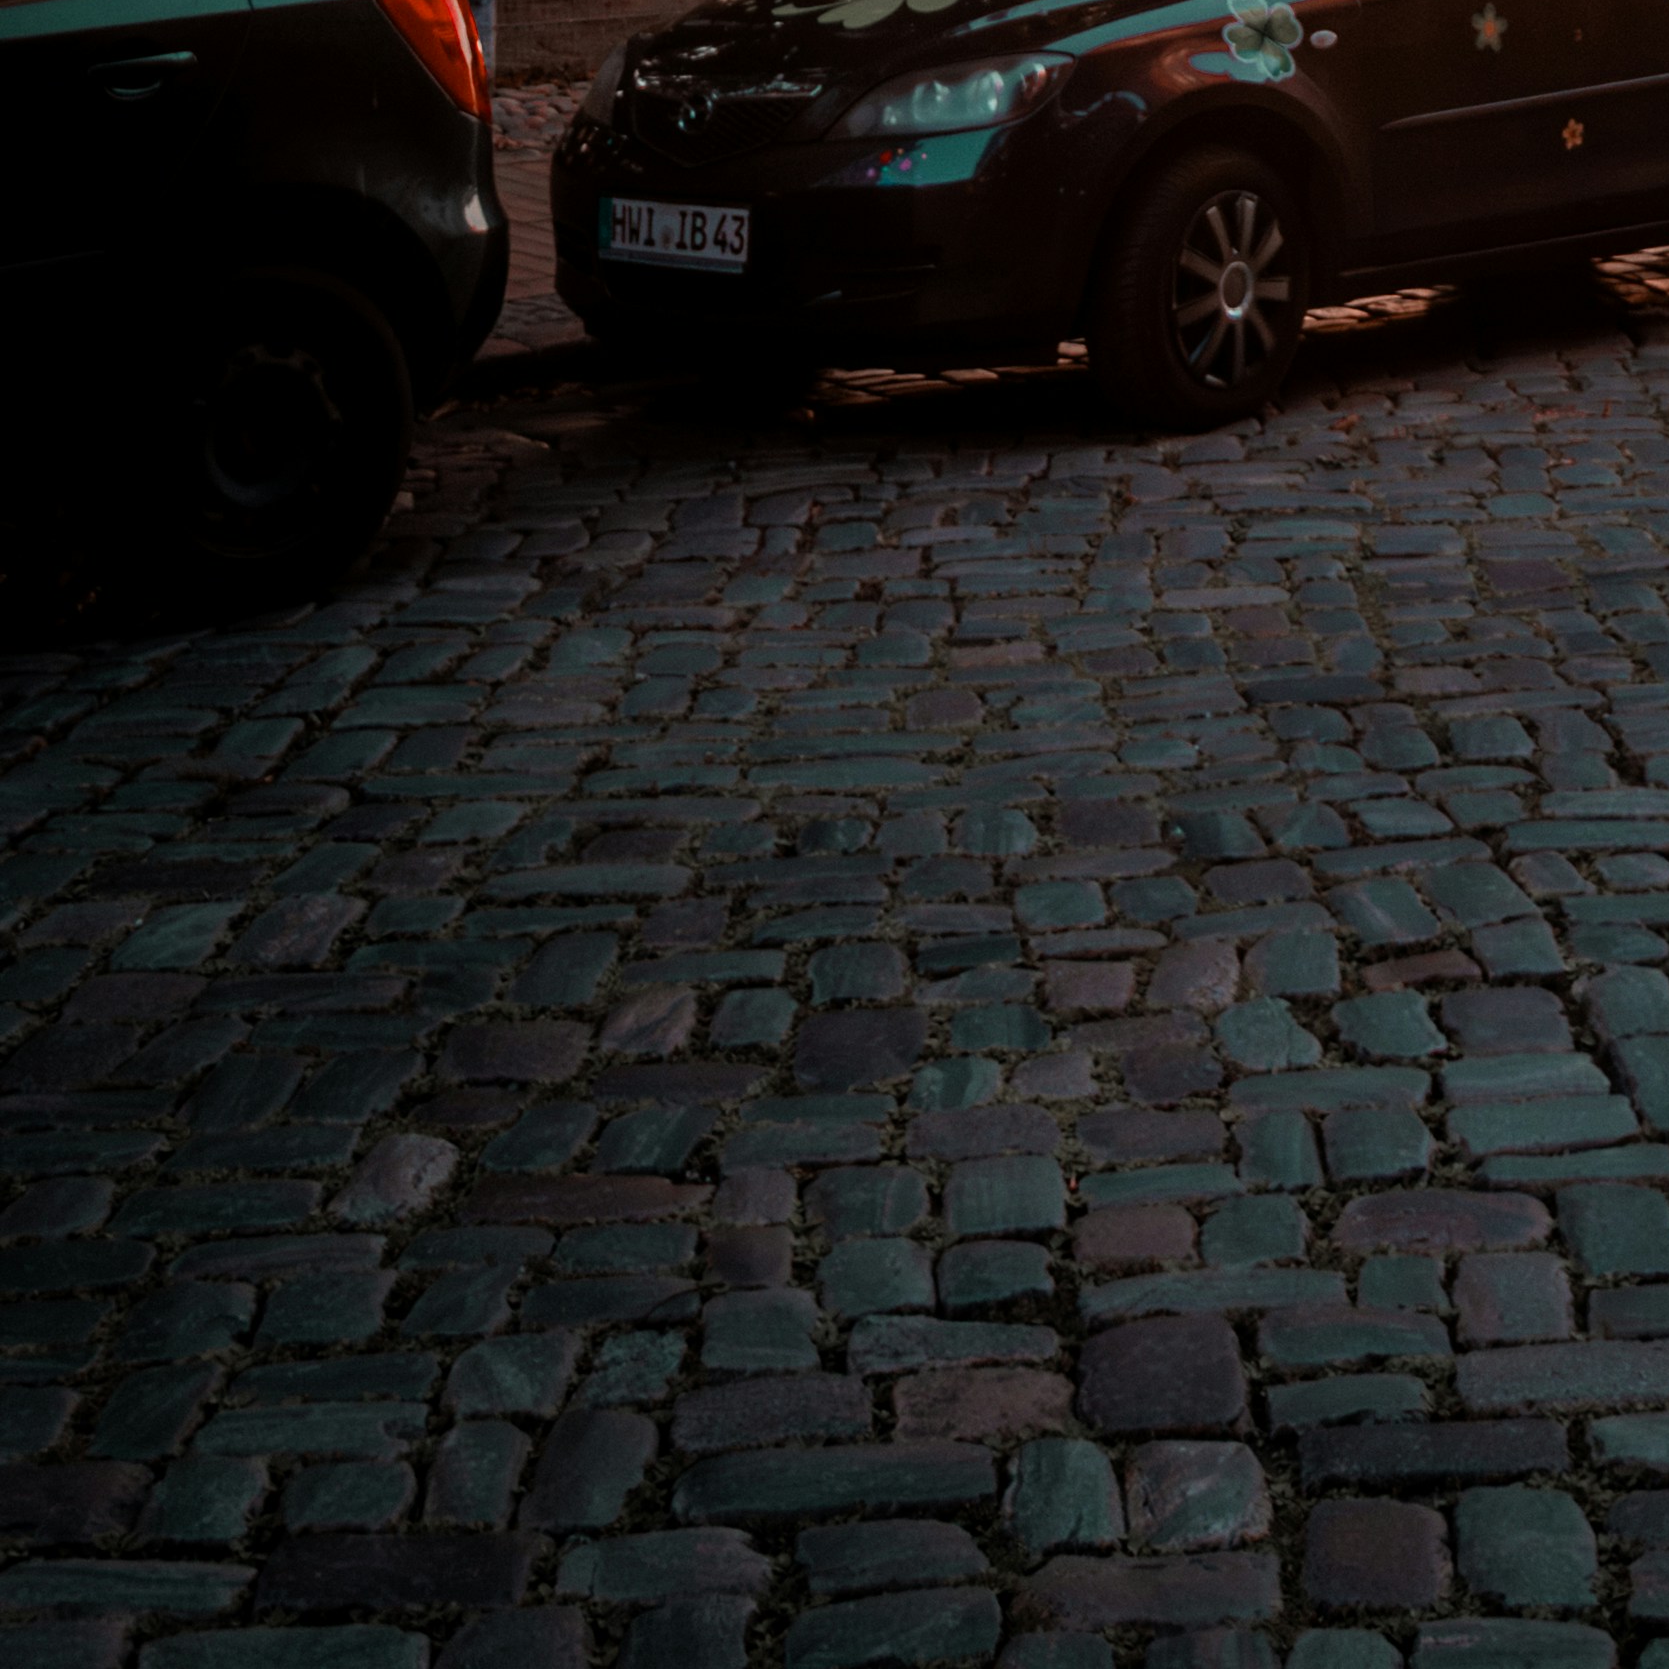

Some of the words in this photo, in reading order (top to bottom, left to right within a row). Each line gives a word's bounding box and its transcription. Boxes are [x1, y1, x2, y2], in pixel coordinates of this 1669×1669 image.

[611, 204, 654, 247] HWI
[675, 210, 706, 251] IB
[713, 214, 745, 255] 43
